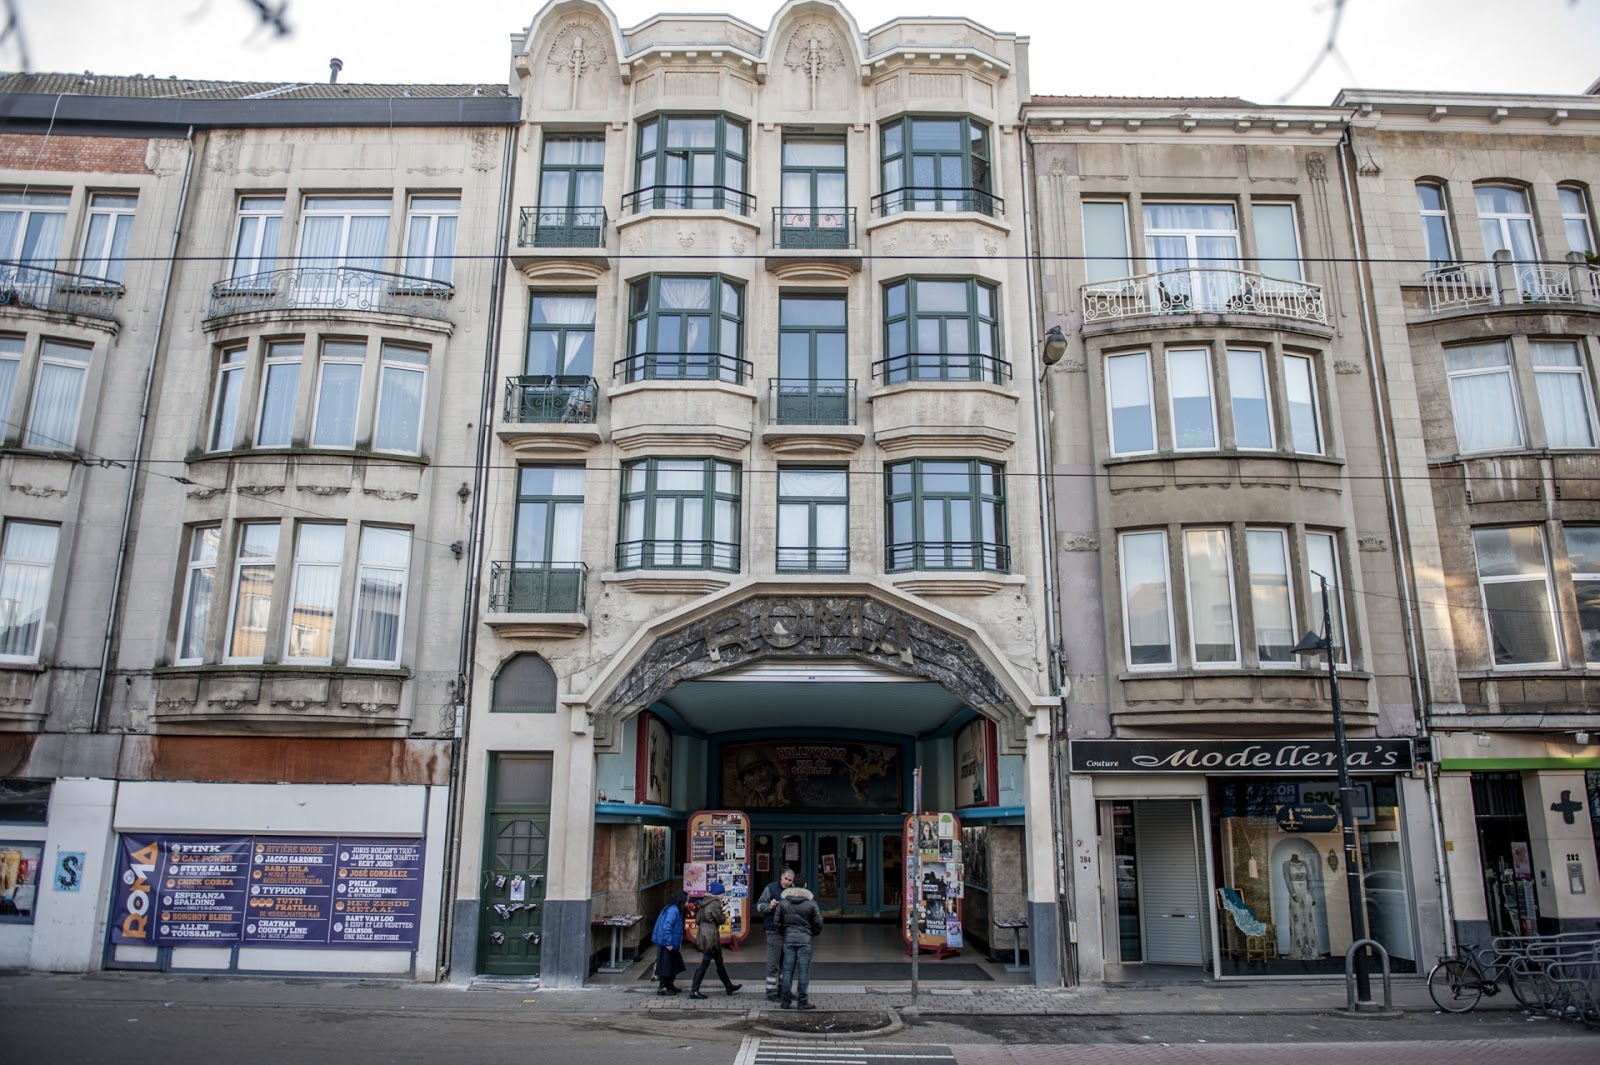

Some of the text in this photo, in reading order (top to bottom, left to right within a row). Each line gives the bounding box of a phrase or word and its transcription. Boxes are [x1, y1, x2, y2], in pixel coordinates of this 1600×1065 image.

[704, 599, 914, 665] ROMA
[776, 746, 846, 759] HOLLYWOOD
[1131, 745, 1398, 767] Modellera's
[182, 845, 221, 853] FINK
[266, 844, 324, 854] RIVIÈRE NOIRE
[201, 855, 233, 863] POWER
[265, 855, 323, 864] JACCO GARDNER
[1566, 853, 1580, 861] 282
[349, 868, 408, 878] JOSÉ GONZÁLEZ
[122, 841, 159, 938] ROMA
[262, 887, 307, 895] TYPHOON
[174, 892, 225, 900] ESPERANZA
[172, 913, 232, 921] SONGHOY BLUES
[180, 923, 209, 931] ALLEN
[171, 930, 221, 938] TOUSSAINT
